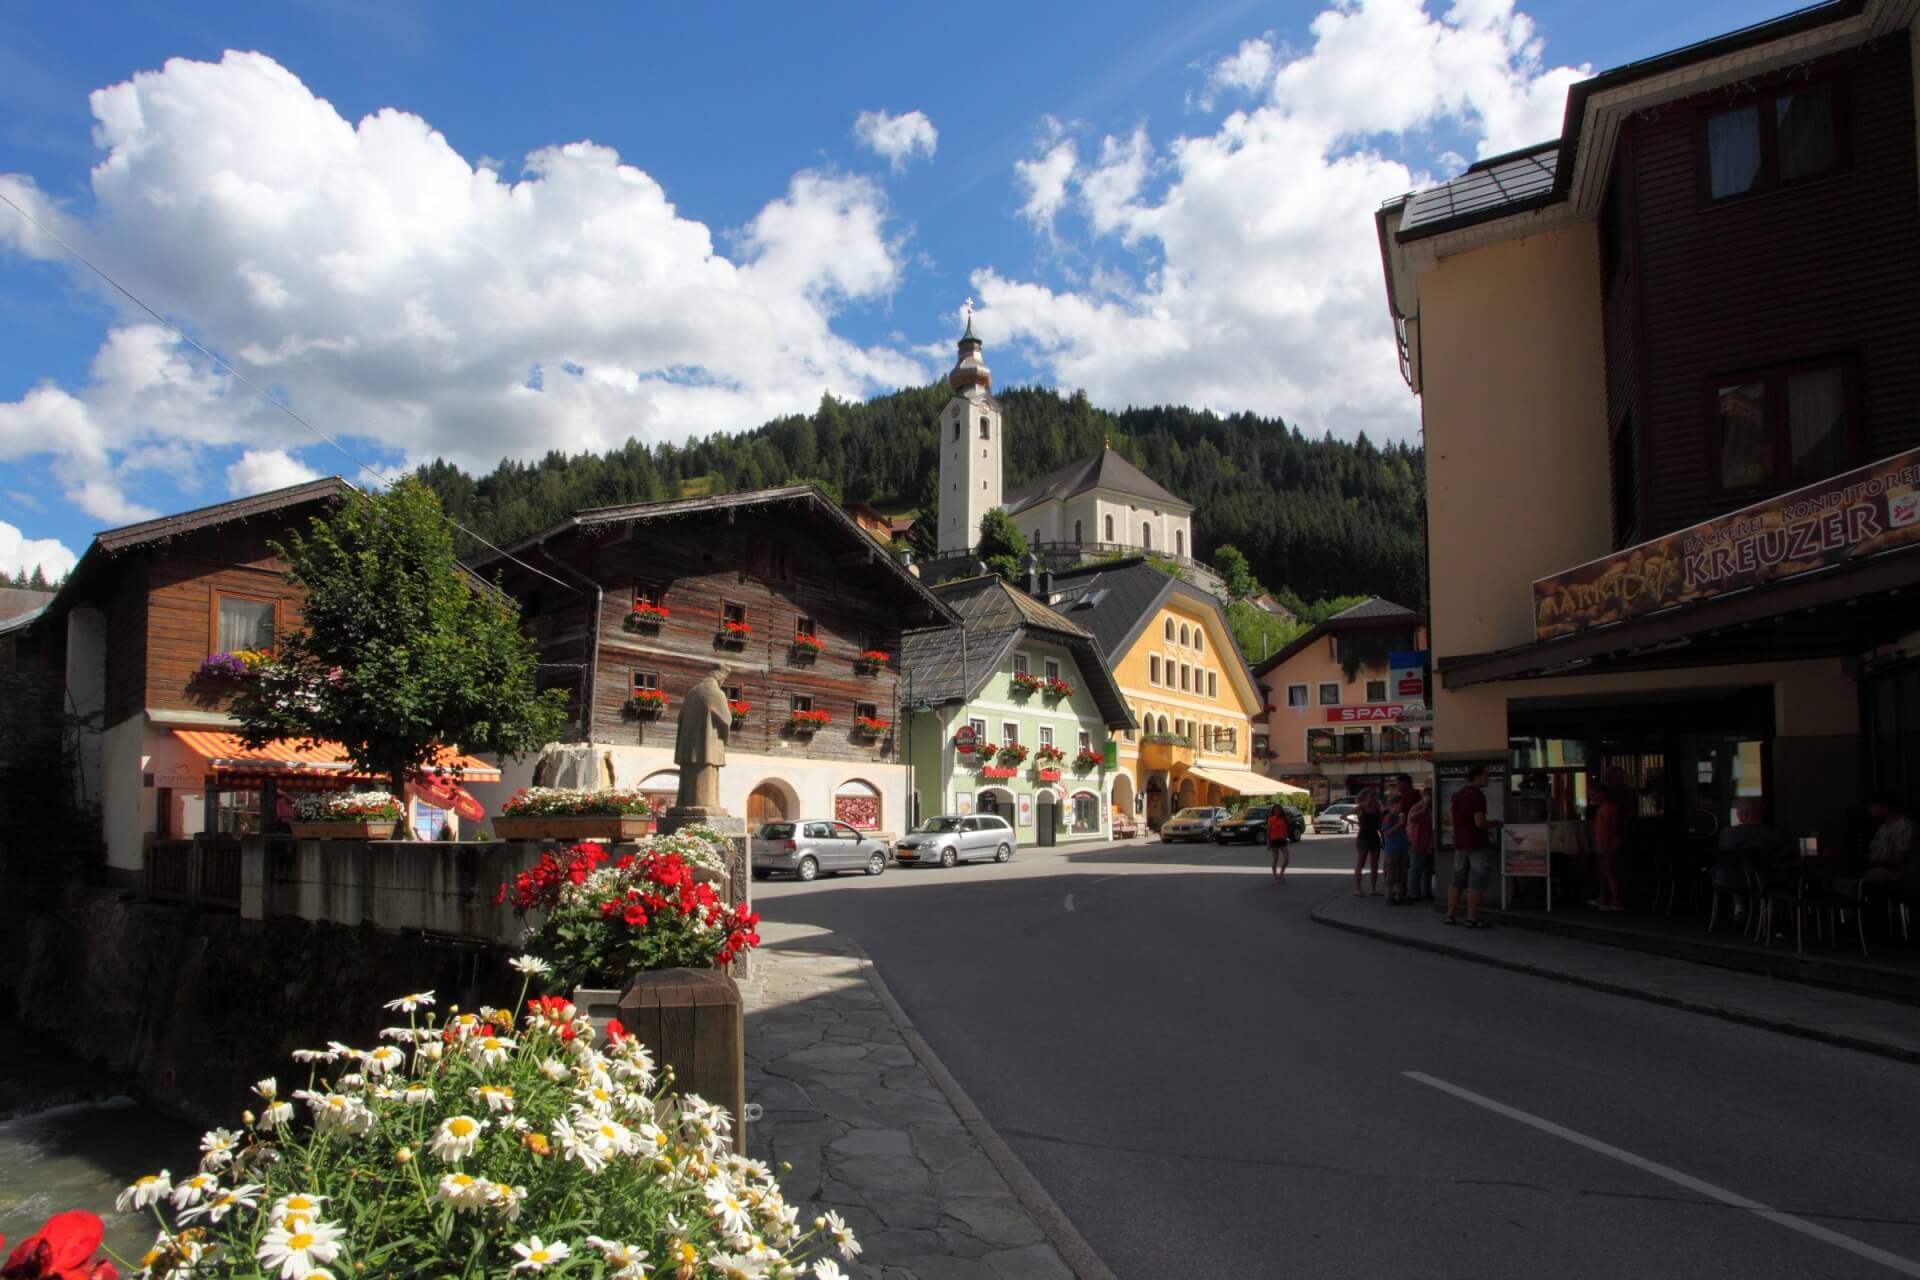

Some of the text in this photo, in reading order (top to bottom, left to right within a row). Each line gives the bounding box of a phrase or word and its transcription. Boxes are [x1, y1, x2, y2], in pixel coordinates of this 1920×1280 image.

[1781, 464, 1920, 523] KONDITOREI
[1684, 503, 1882, 586] KREUZER
[1341, 707, 1403, 720] SPAR
